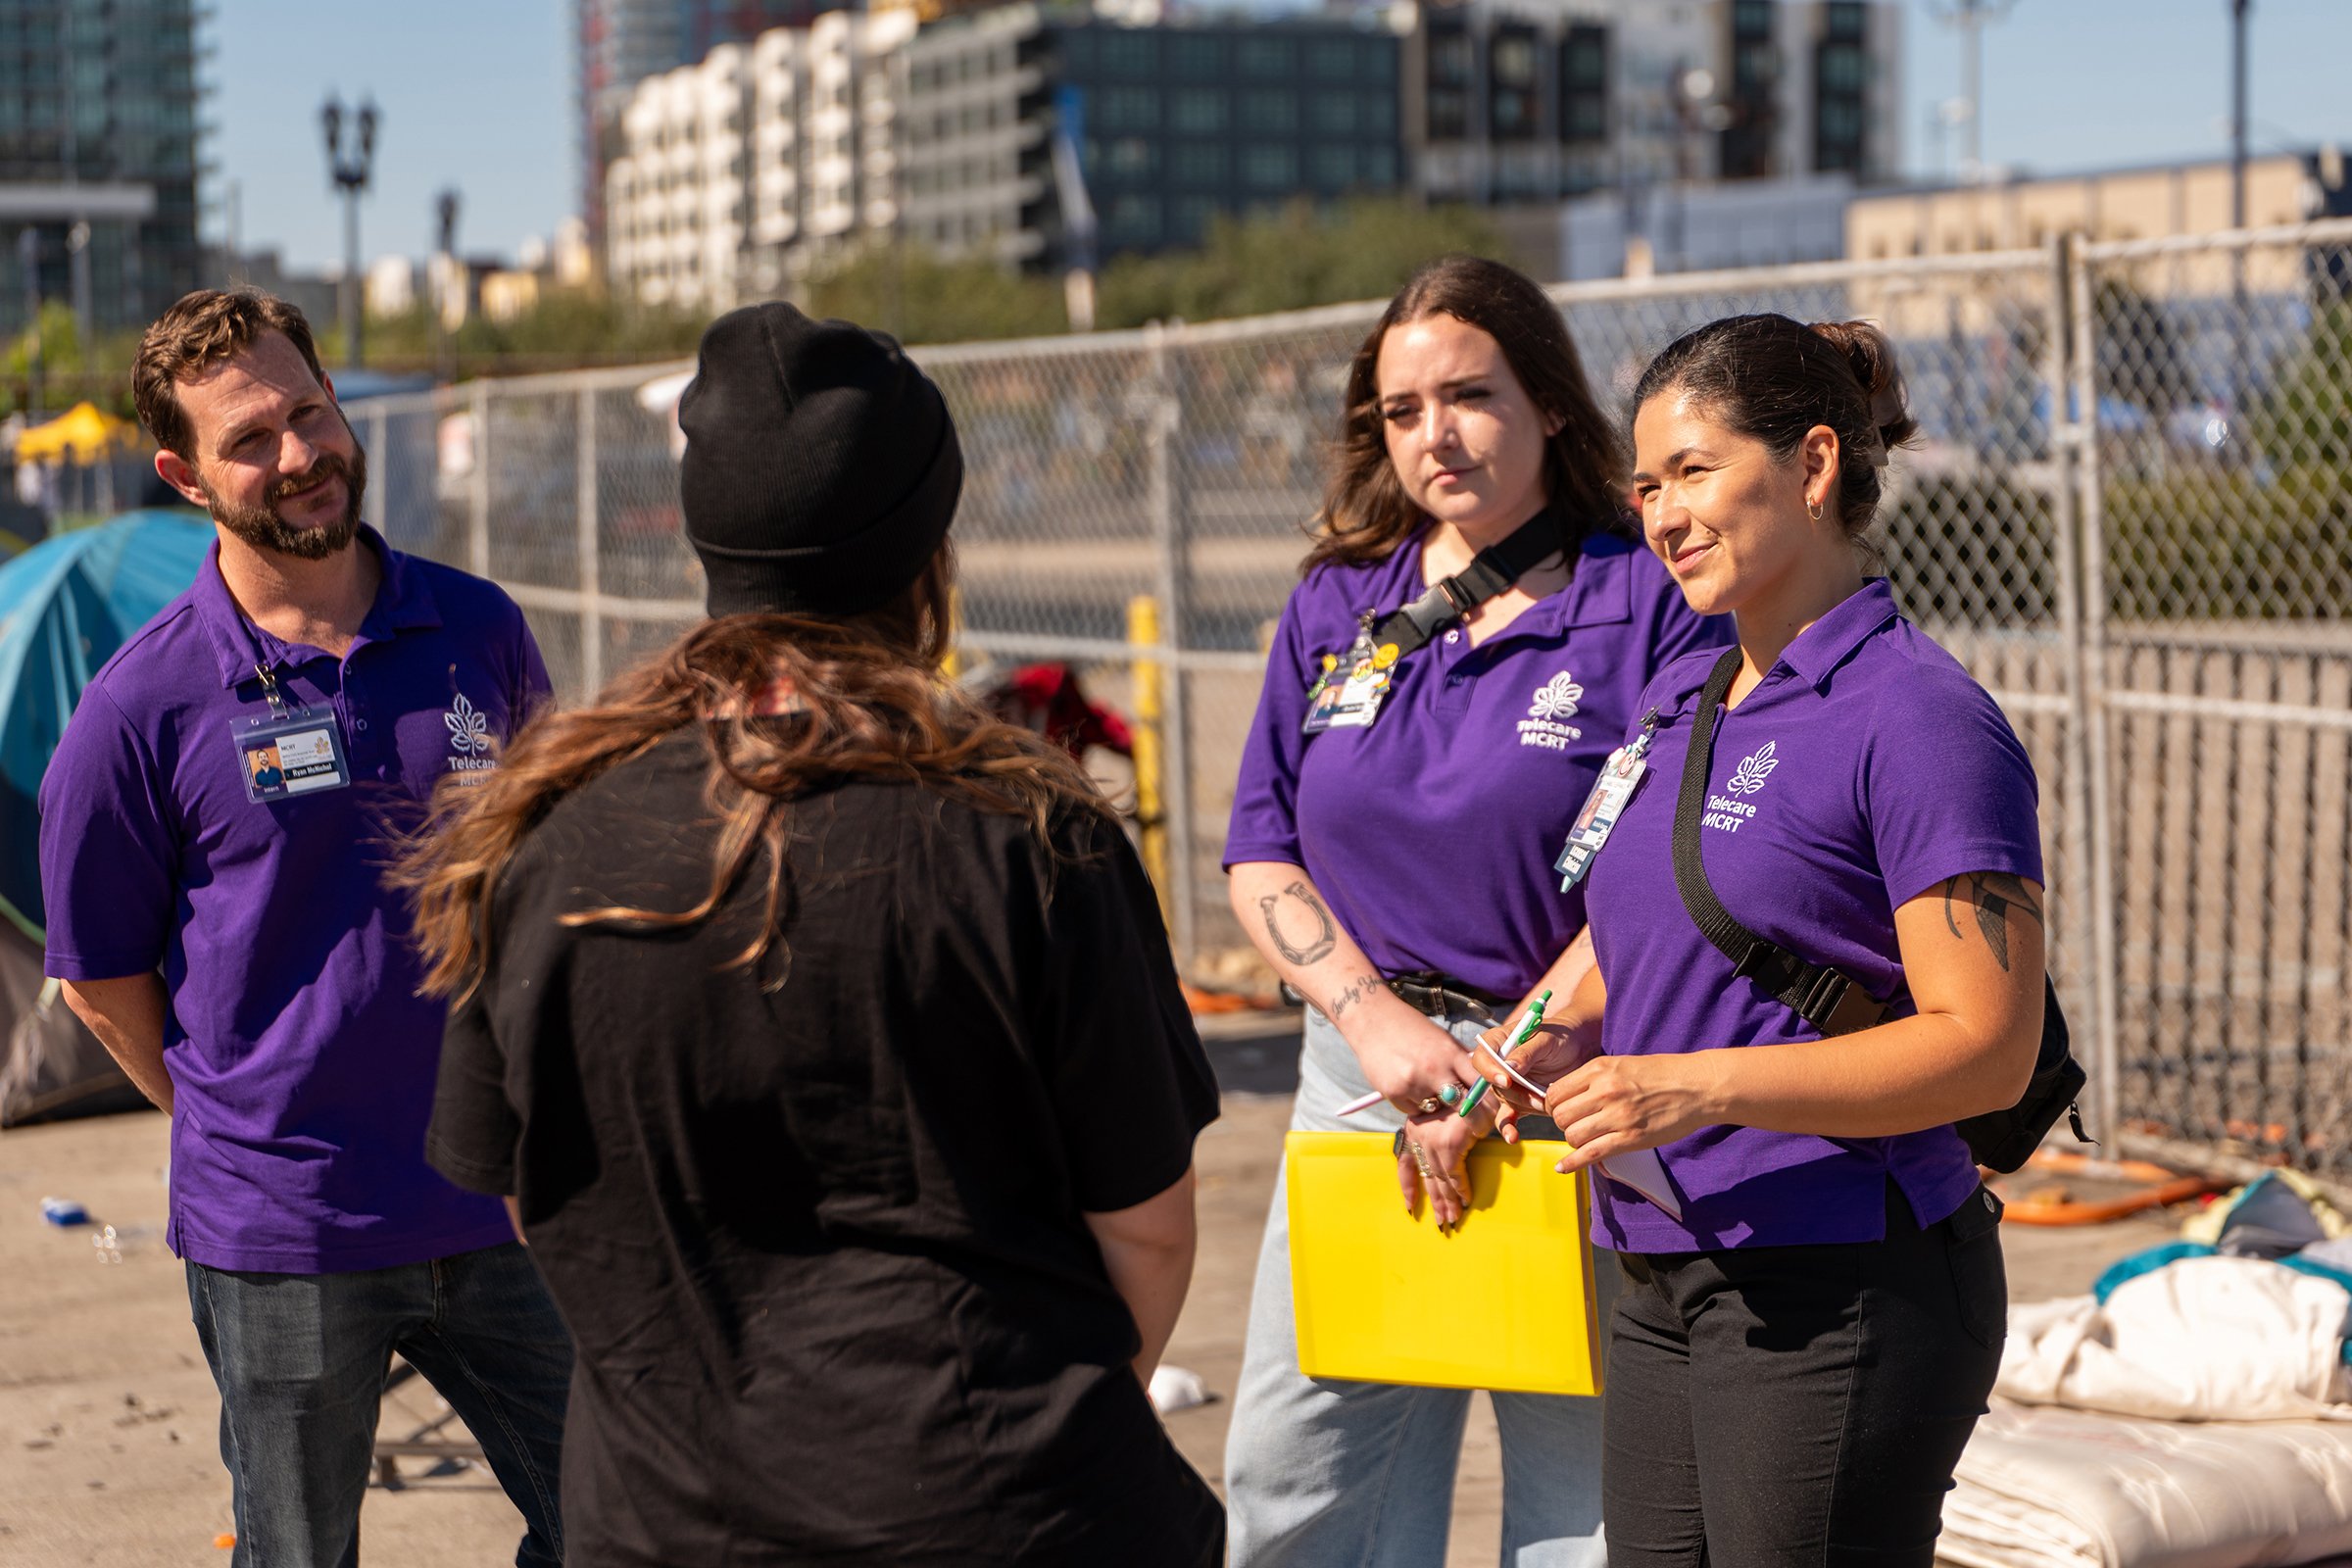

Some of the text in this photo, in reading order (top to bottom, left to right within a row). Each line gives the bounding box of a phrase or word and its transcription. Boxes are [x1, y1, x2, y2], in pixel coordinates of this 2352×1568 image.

[1517, 717, 1582, 740] Telecare
[1520, 732, 1569, 751] MCRT
[292, 767, 308, 777] Ryan
[459, 772, 490, 786] MCR
[1707, 795, 1757, 817] Telecare
[1701, 812, 1744, 833] MCRT
